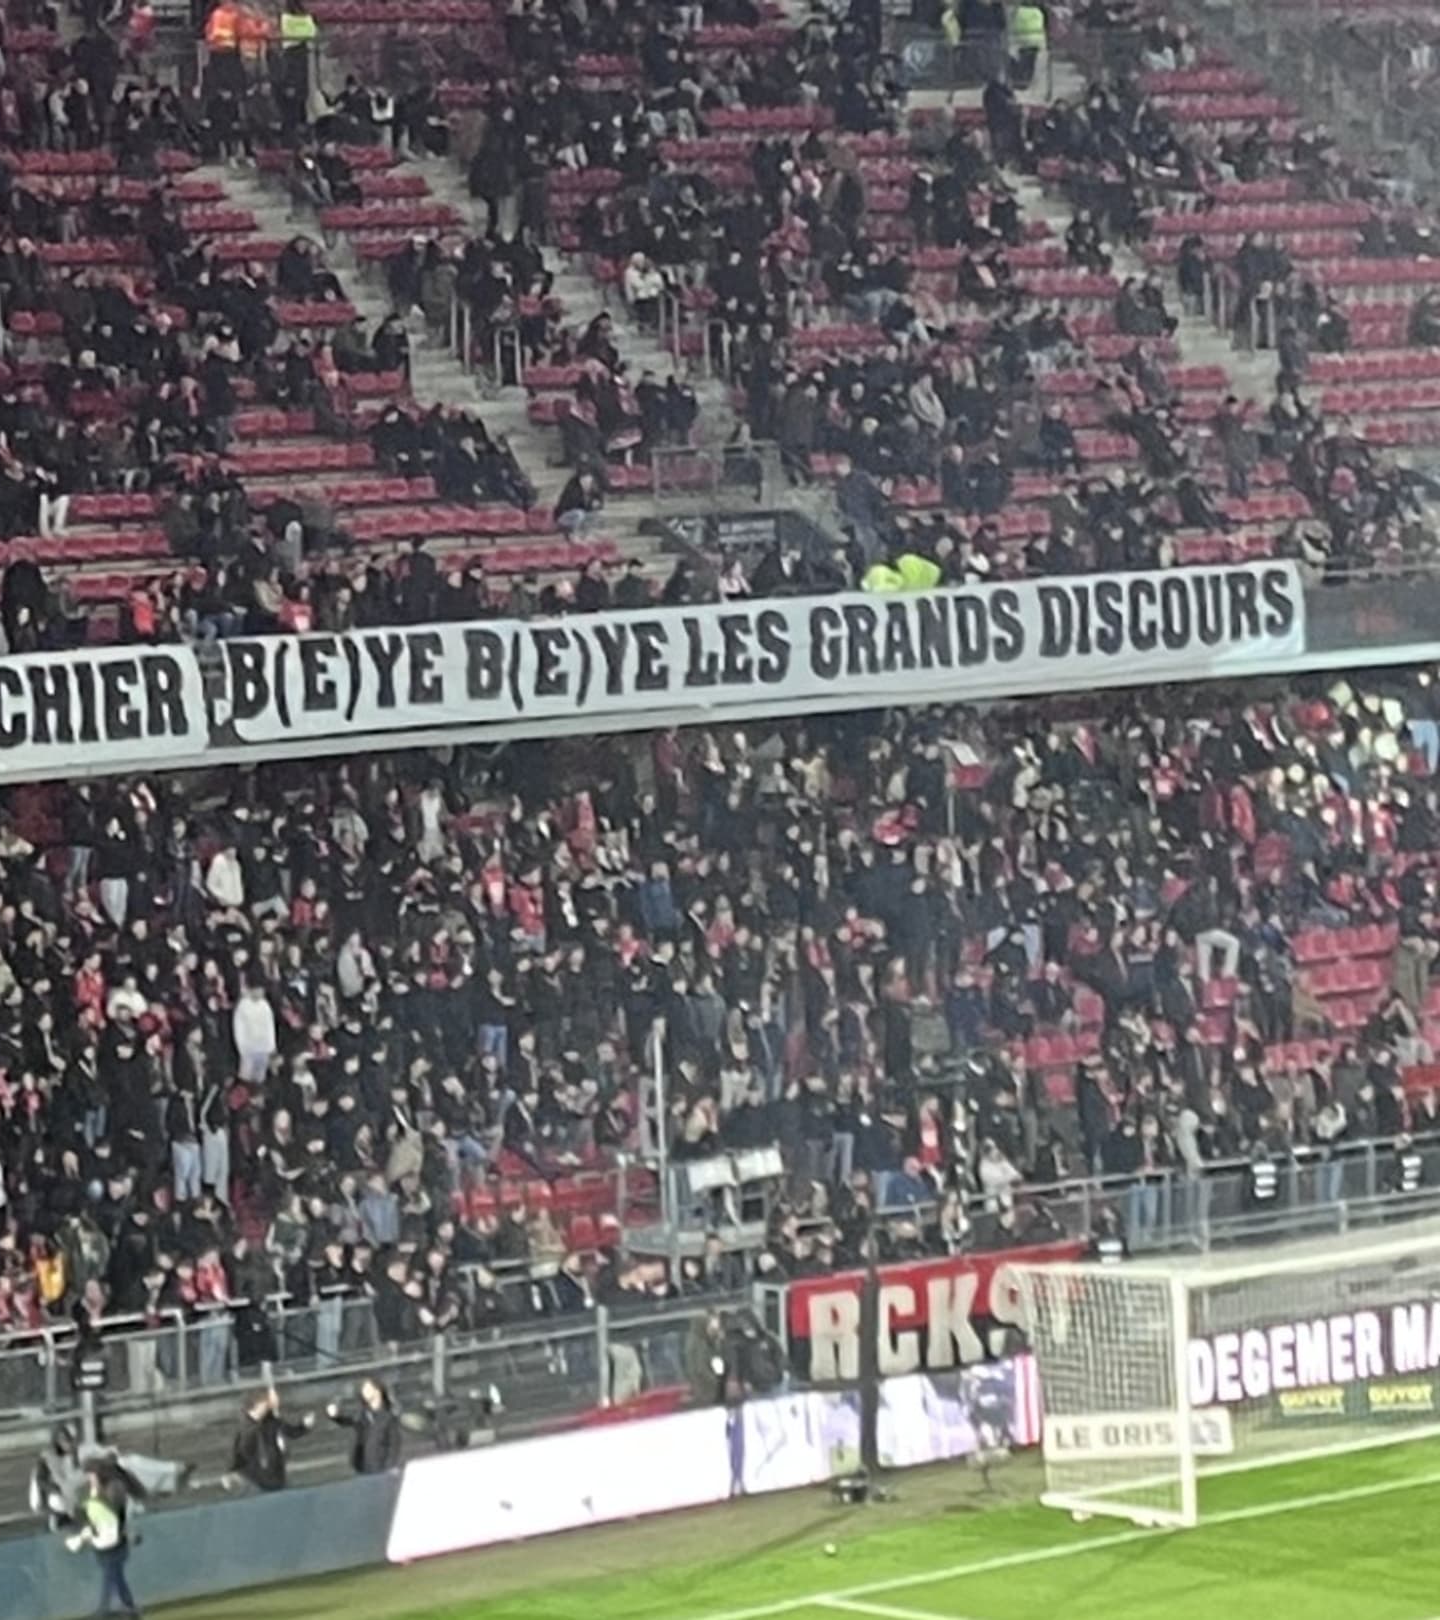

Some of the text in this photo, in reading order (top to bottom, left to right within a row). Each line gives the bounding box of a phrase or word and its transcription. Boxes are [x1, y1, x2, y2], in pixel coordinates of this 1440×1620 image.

[227, 569, 1295, 728] B(E)YE B(E)YE LES GRANDS DISCOURS
[1187, 1311, 1385, 1407] DEGEMER
[1055, 1424, 1092, 1450] LE
